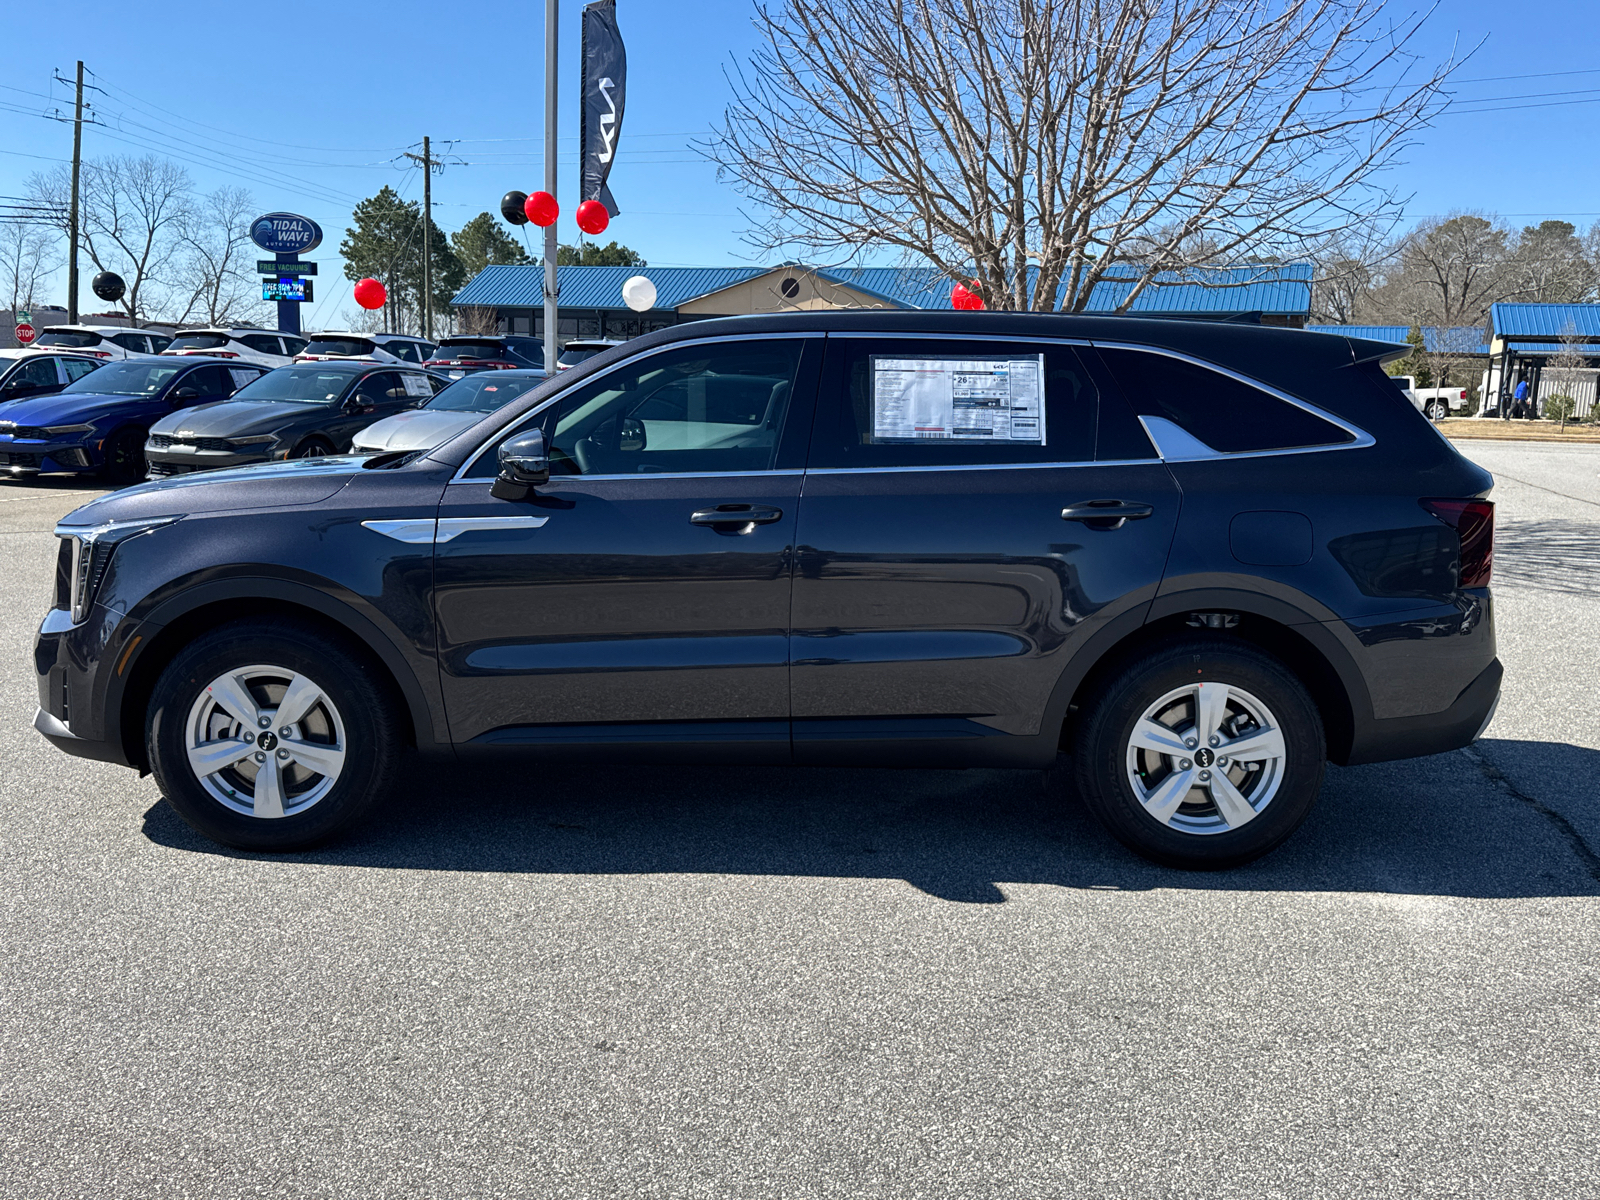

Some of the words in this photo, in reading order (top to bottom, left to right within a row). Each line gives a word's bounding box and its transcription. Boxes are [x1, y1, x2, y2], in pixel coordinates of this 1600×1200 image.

[273, 220, 303, 231] TIDAL
[278, 231, 310, 242] WAVE
[260, 263, 276, 271] FREE
[277, 264, 309, 272] VACUUMS
[17, 329, 34, 338] STOP
